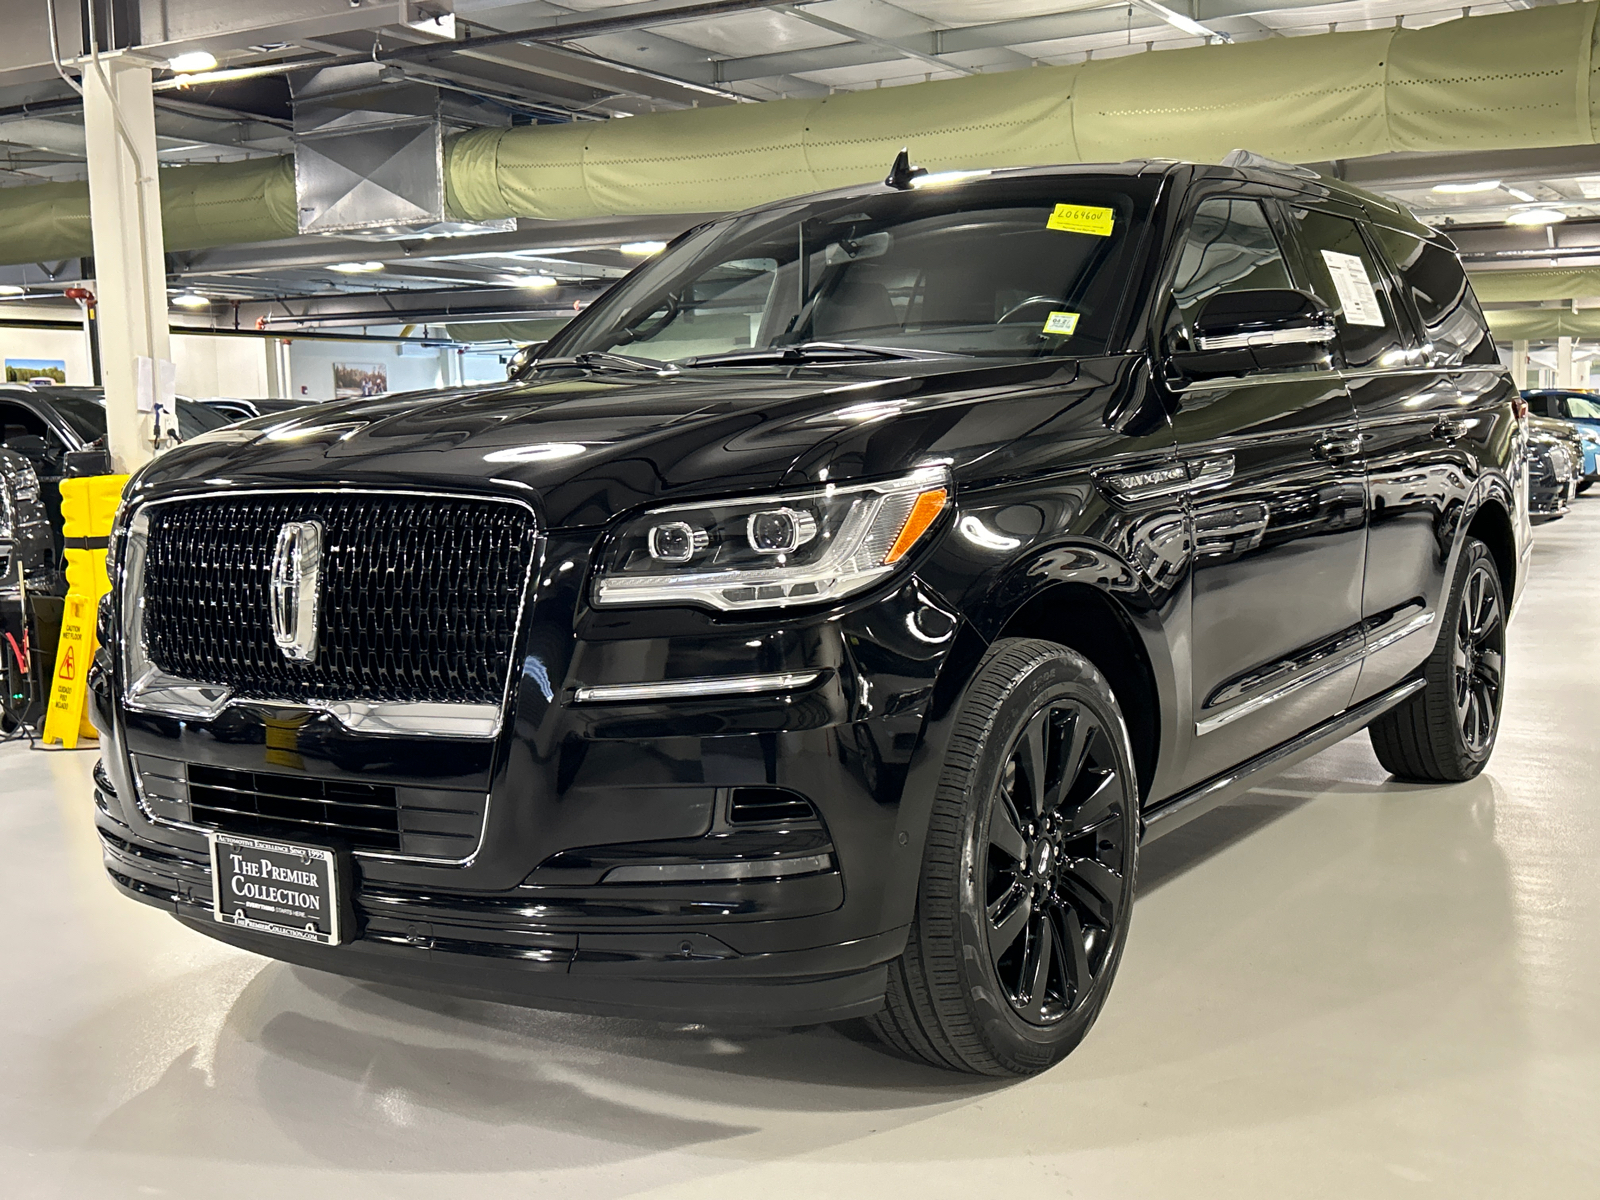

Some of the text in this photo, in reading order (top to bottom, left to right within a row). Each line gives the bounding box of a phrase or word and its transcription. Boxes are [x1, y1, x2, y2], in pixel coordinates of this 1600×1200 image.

[1120, 468, 1183, 488] NAVIGATOR
[218, 835, 254, 847] AUTOMOTIVE
[254, 841, 289, 853] EXCELLENCE
[289, 846, 306, 856] SINCE
[229, 853, 319, 888] THE PREMIER
[231, 875, 320, 910] COLLECTION
